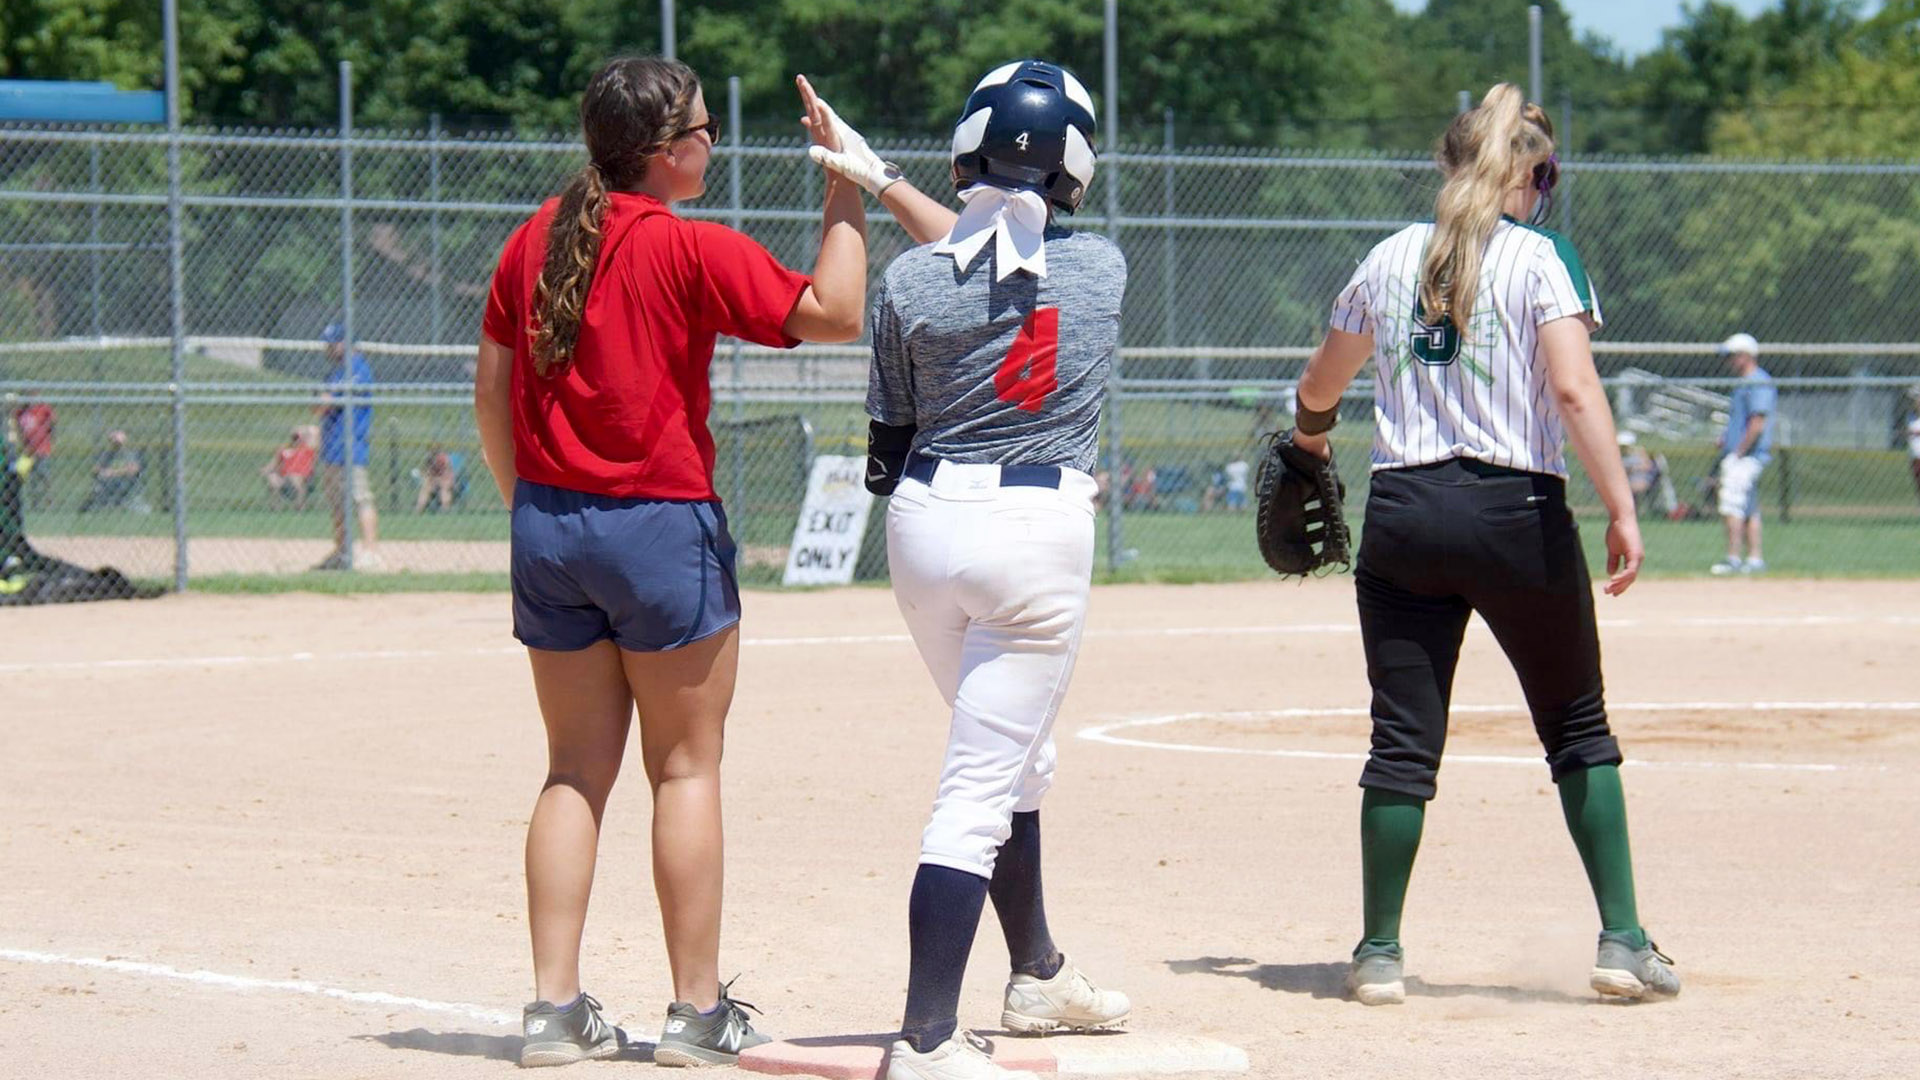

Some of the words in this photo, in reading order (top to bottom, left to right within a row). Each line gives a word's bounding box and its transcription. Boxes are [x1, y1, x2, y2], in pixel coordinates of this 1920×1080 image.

[1015, 132, 1029, 150] 4
[993, 307, 1059, 413] 4
[808, 511, 854, 533] EXIT
[796, 548, 853, 569] ONLY
